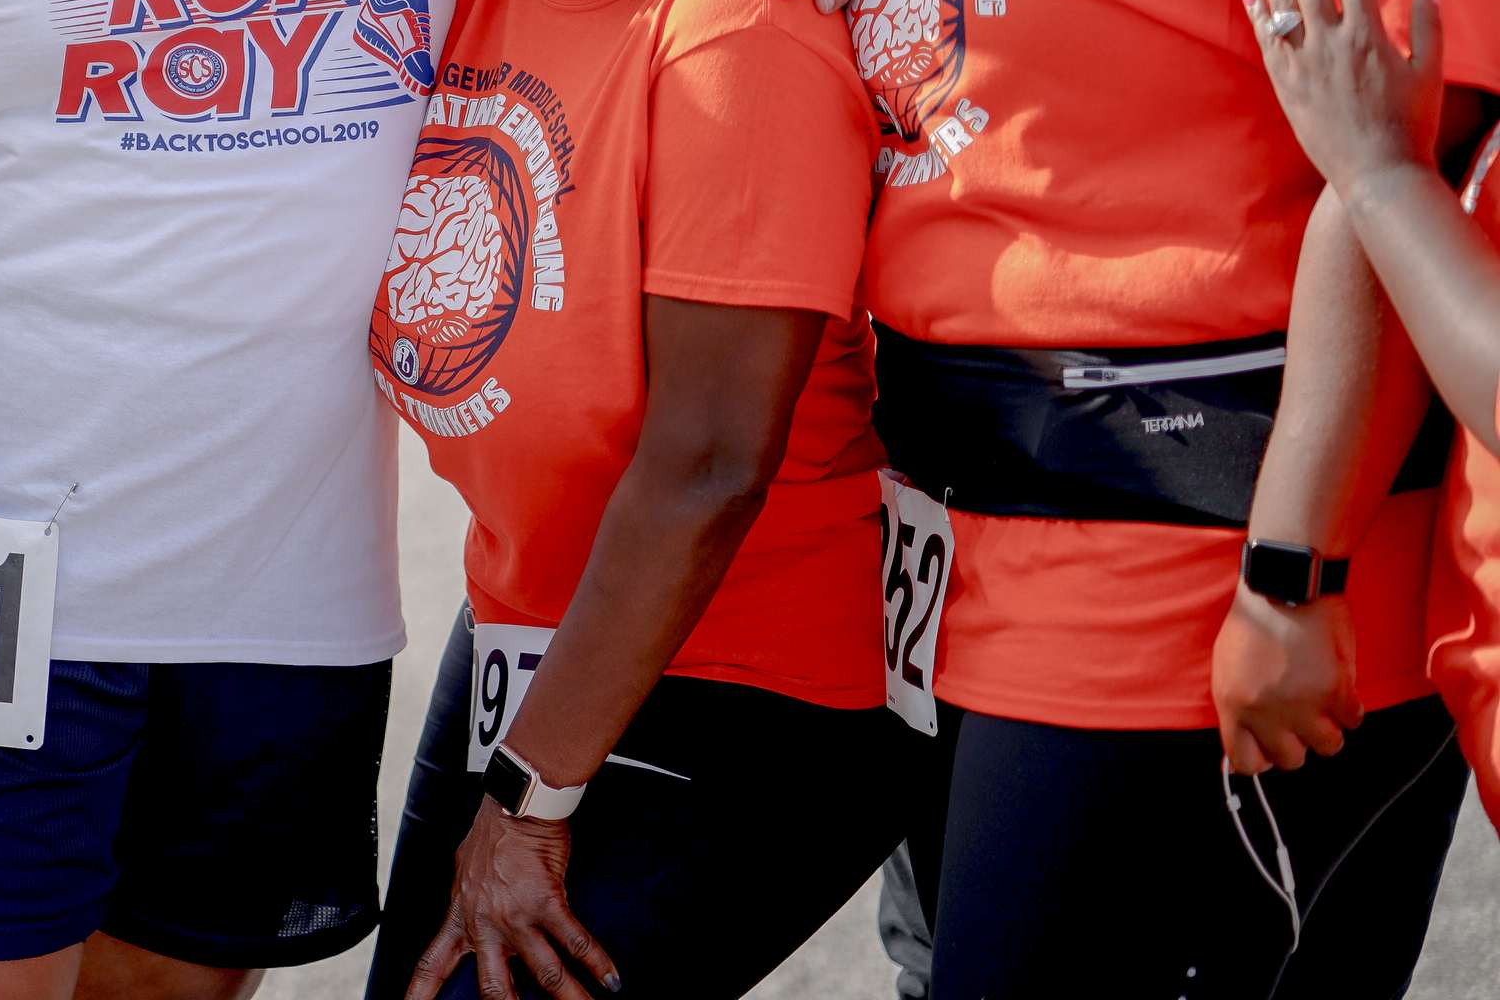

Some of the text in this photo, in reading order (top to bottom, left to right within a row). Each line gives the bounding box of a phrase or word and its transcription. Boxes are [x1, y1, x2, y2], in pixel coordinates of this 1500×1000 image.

[179, 55, 211, 83] SCS
[507, 70, 558, 123] MIDDLE
[120, 120, 380, 152] #BACKTOSCHOOL2019
[880, 502, 946, 692] 52
